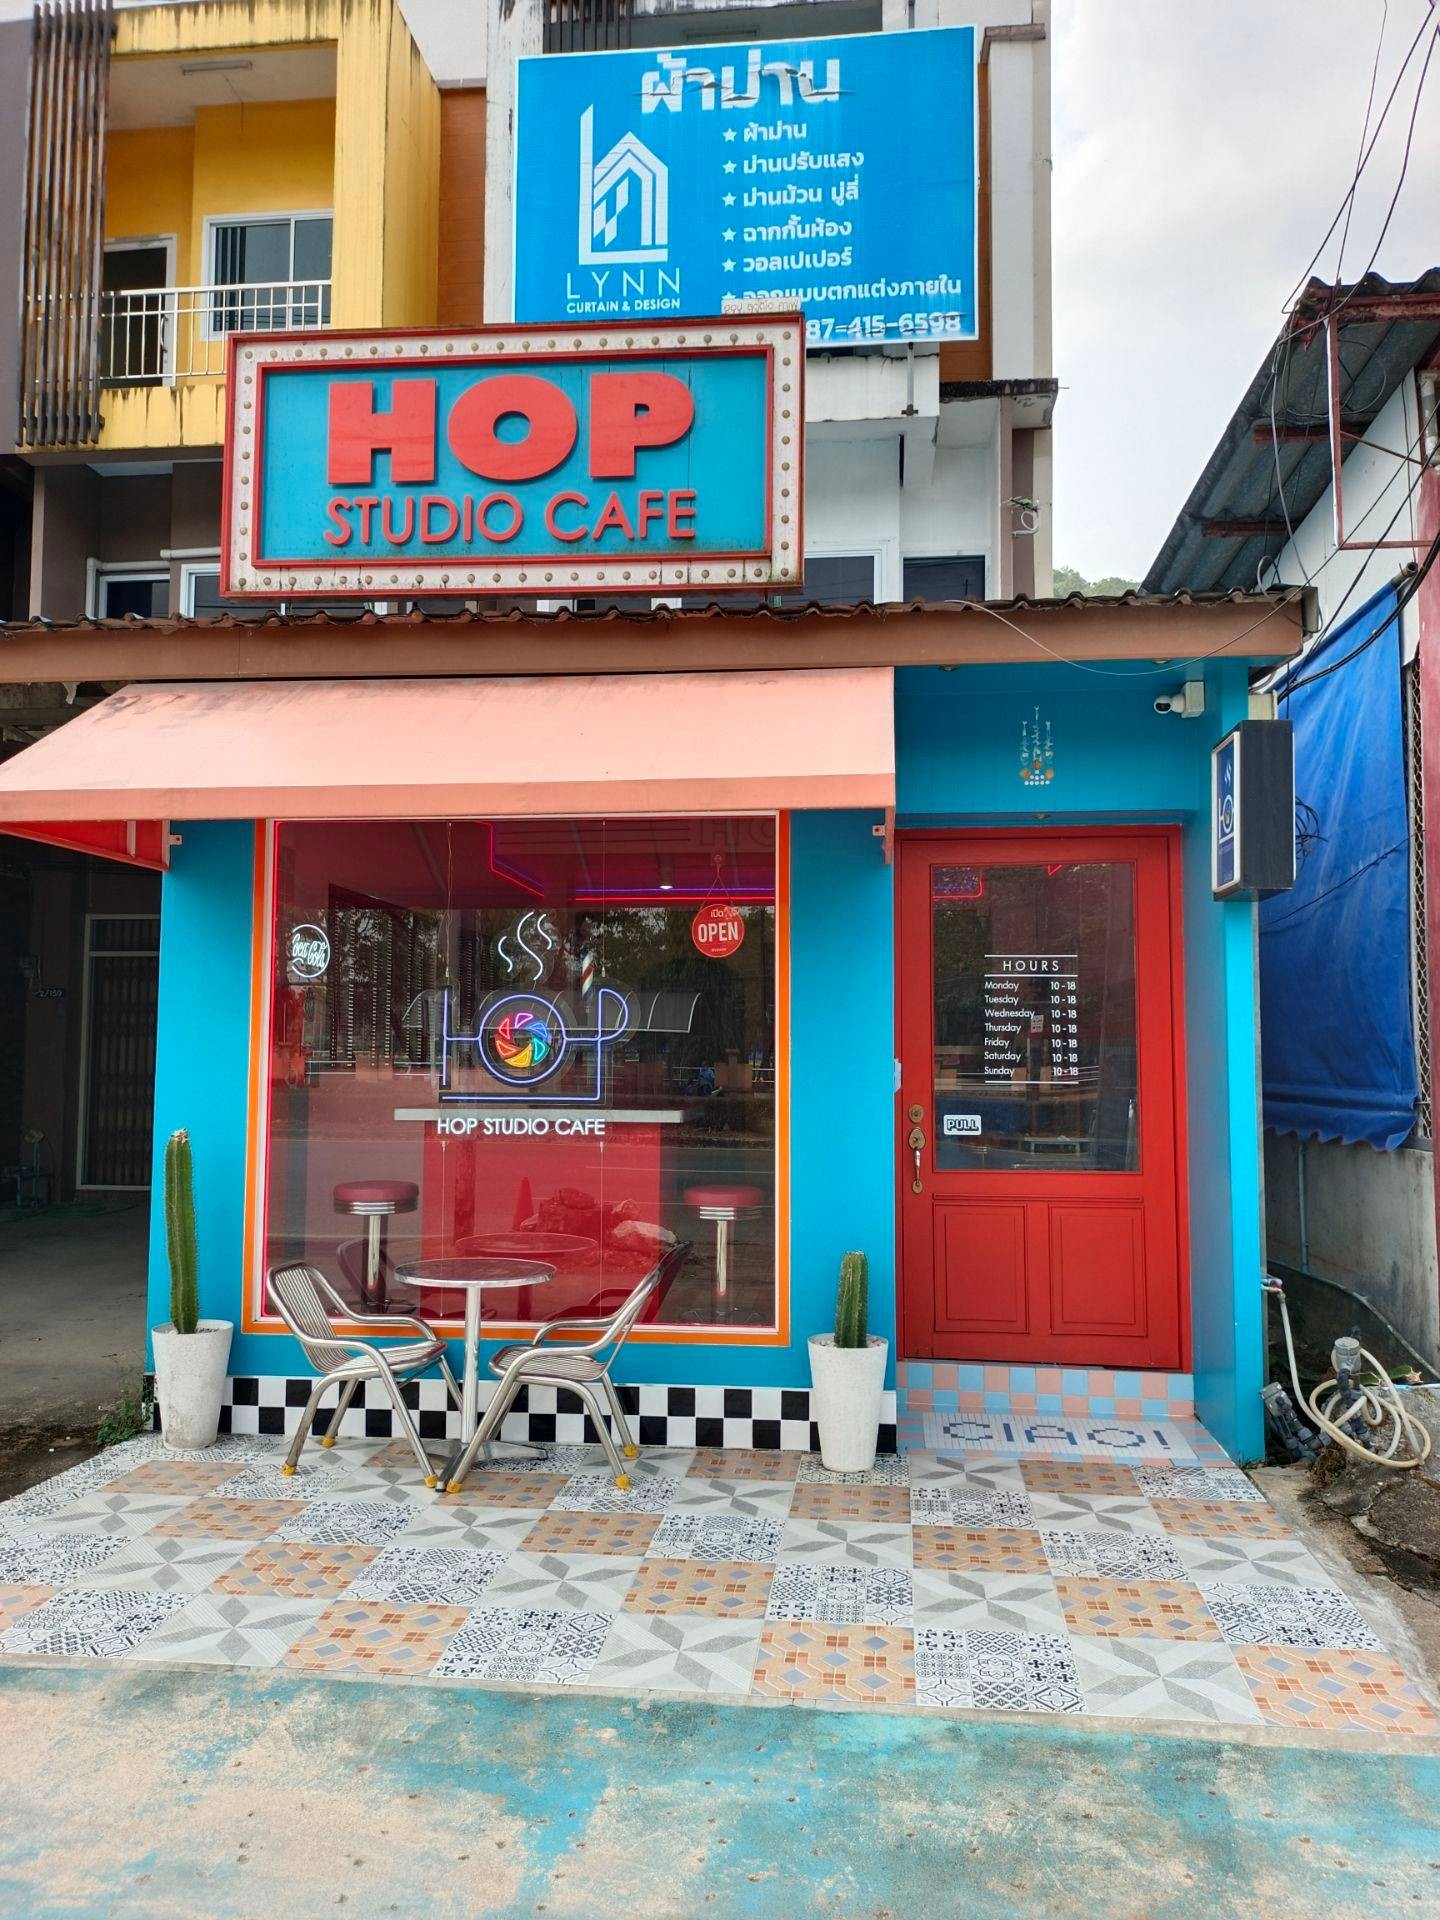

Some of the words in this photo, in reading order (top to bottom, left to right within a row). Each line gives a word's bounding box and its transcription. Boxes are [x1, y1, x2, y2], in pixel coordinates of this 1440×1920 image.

[641, 48, 840, 114] ผ้าม่าน
[743, 120, 807, 142] ผ้าม่าน
[743, 150, 865, 174] ม่านปรับแสง
[743, 183, 823, 207] ม่านม้วน
[743, 214, 853, 243] ฉากกั้นห้อง
[743, 246, 853, 273] วอลเปเปอร์
[566, 267, 681, 300] LYNN
[566, 301, 619, 314] CURTAIN
[621, 300, 631, 312] &
[634, 298, 681, 311] DESIGN
[327, 371, 696, 486] HOP
[323, 491, 525, 547] STUDIO
[544, 488, 698, 543] CAFE
[697, 921, 739, 943] OPEN
[1003, 960, 1059, 972] HOURS
[984, 980, 1020, 992] Monday
[984, 994, 1020, 1006] Tuesday
[984, 1008, 1035, 1020] Wednesday
[984, 1022, 1022, 1034] Thursday
[442, 988, 629, 1100] HOP
[984, 1036, 1010, 1049] Friday
[984, 1051, 1022, 1063] Saturday
[984, 1066, 1015, 1077] Sunday
[437, 1118, 478, 1135] HOP
[483, 1118, 550, 1135] STUDIO
[554, 1118, 606, 1136] CAFE
[946, 1118, 979, 1131] PULL
